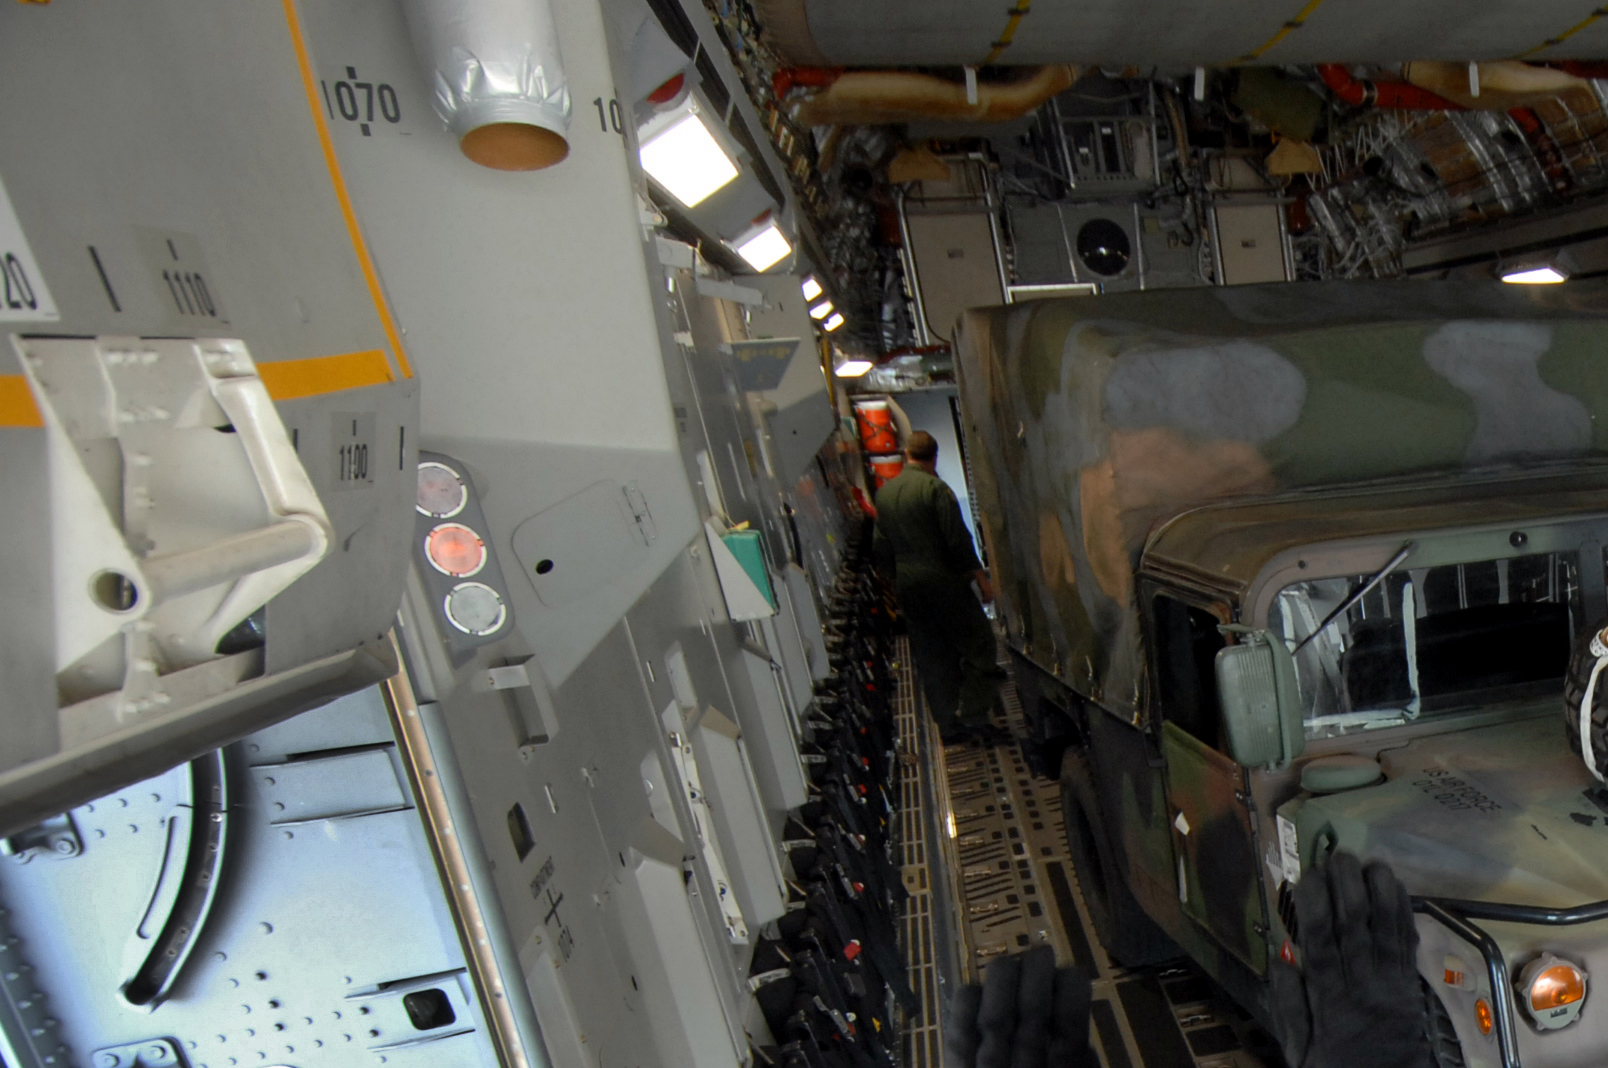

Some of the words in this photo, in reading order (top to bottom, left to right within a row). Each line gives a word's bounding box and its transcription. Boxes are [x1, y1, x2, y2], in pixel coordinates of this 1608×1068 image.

[0, 253, 38, 310] 20
[162, 269, 217, 318] 1110
[339, 444, 368, 481] 1100
[1422, 766, 1449, 778] US
[1454, 785, 1503, 813] FORCE
